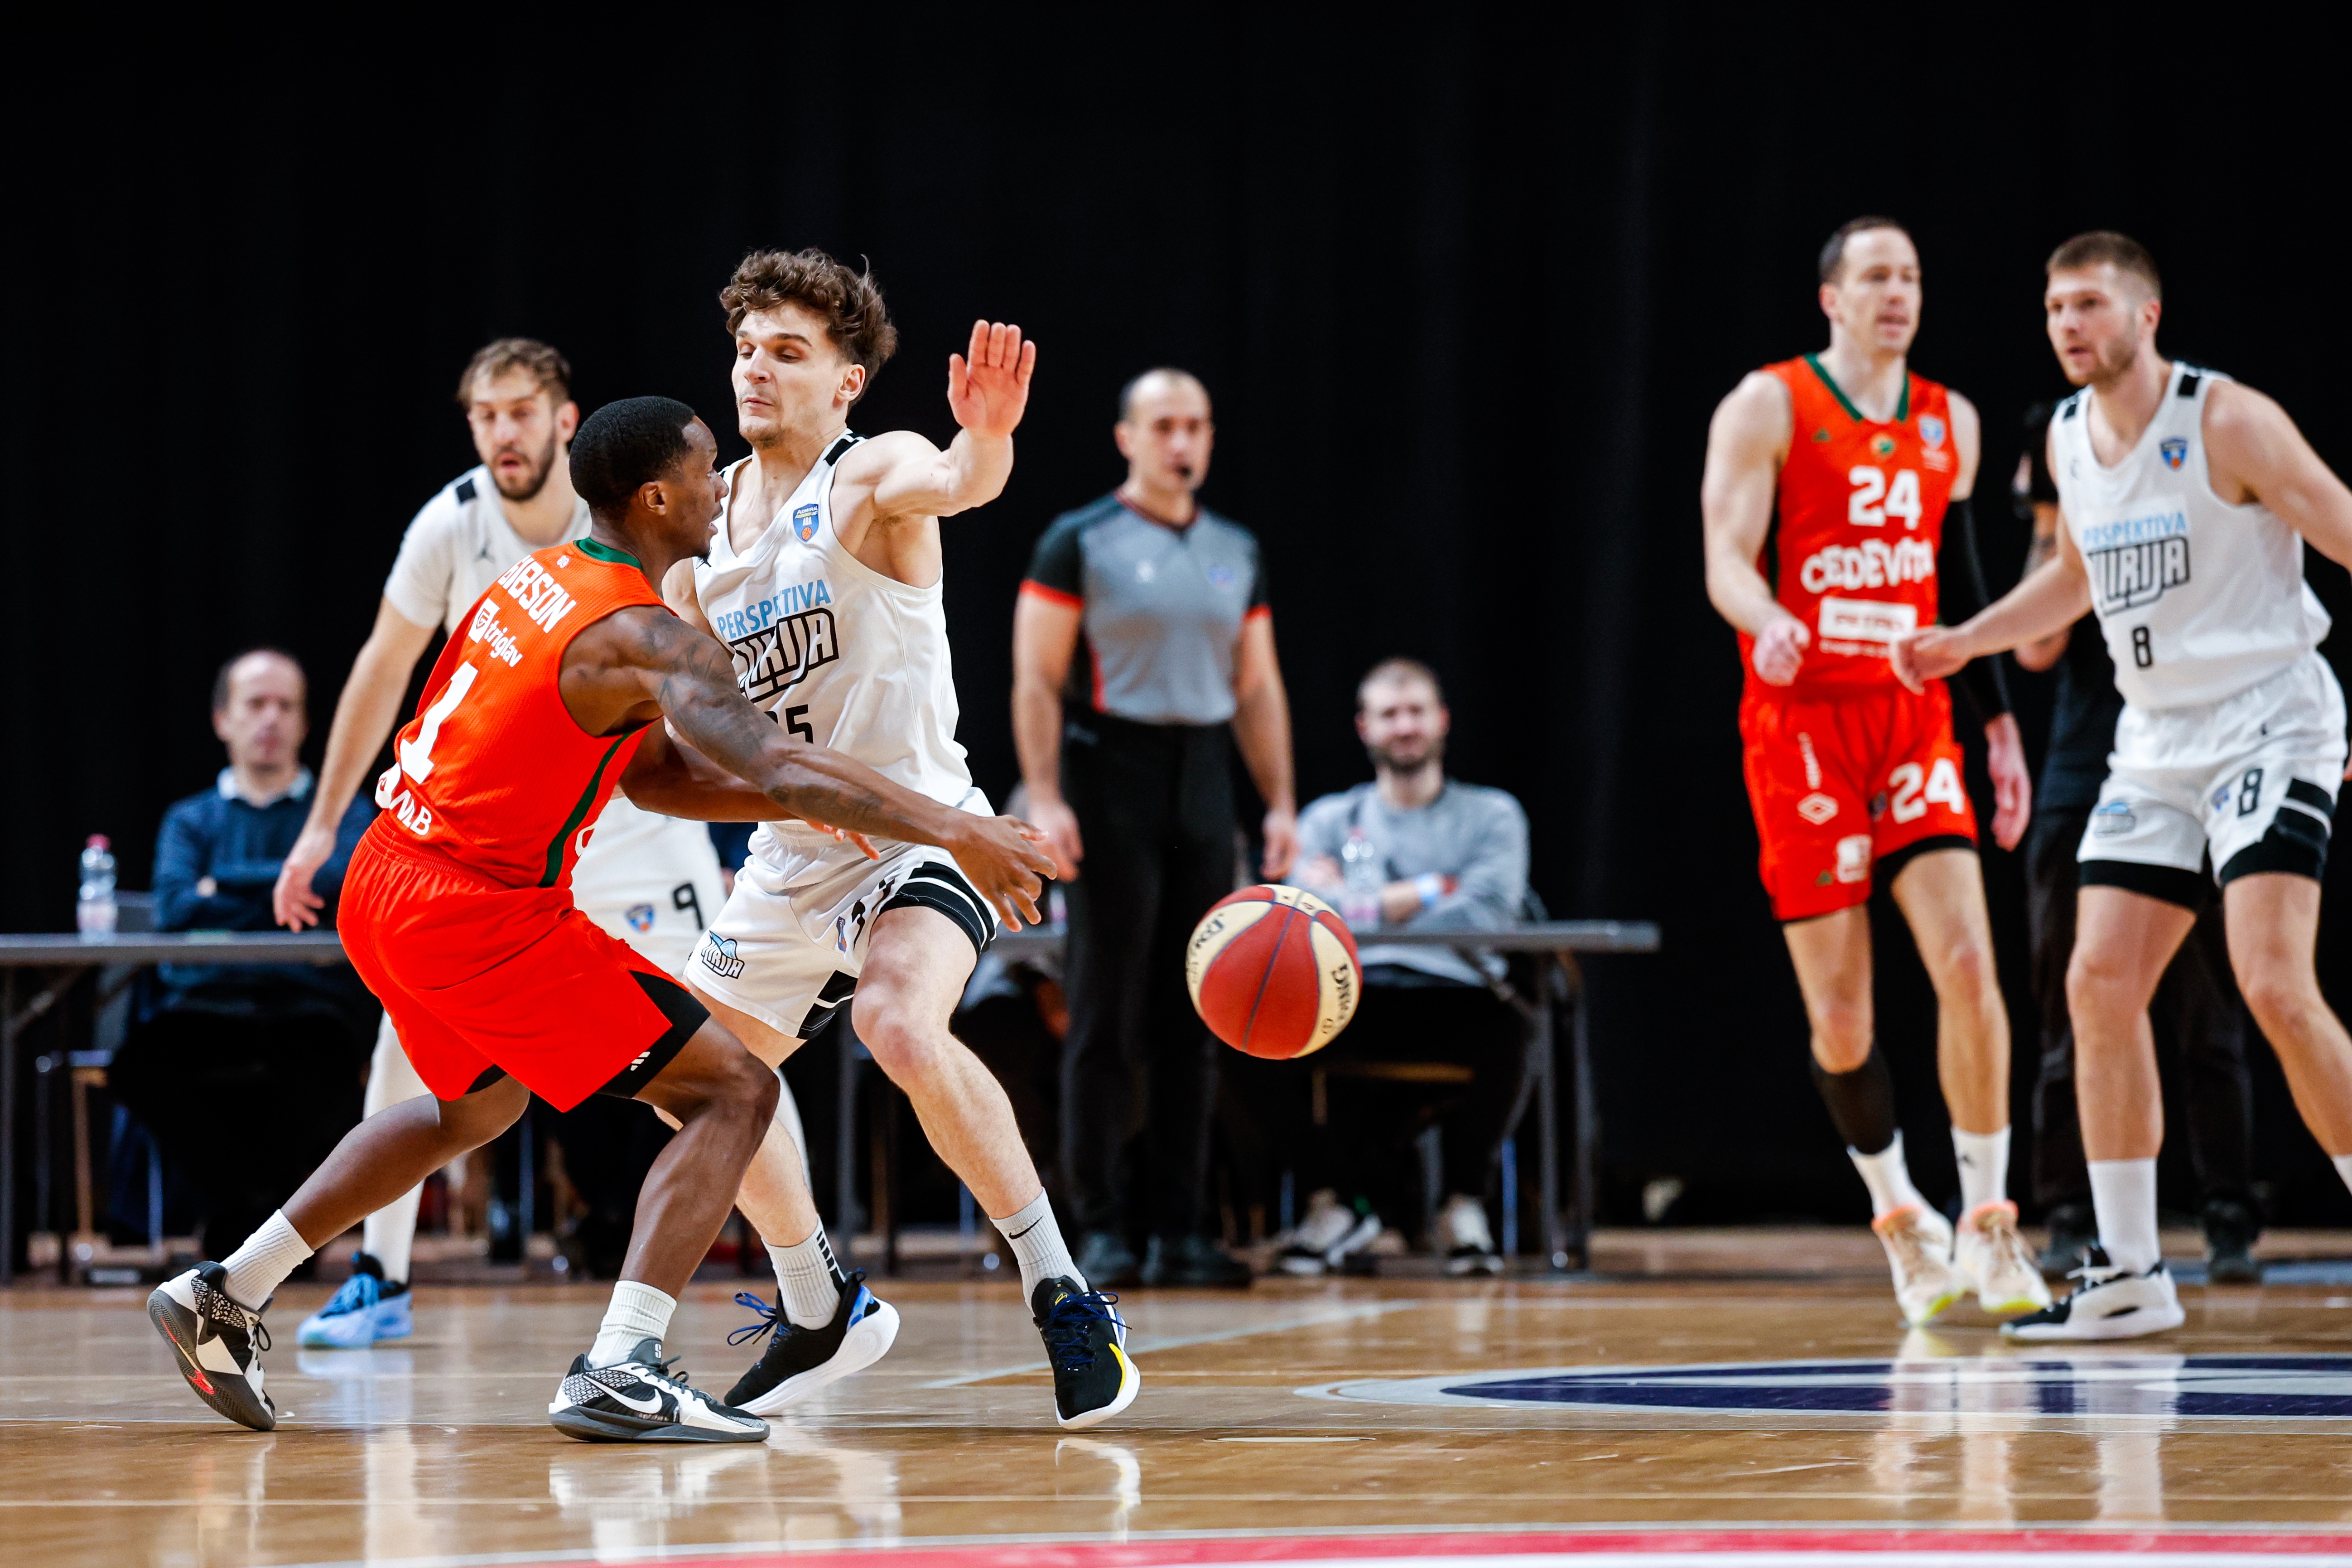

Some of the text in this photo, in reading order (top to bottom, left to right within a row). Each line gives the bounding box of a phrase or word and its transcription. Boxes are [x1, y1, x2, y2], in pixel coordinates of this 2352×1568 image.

[797, 506, 818, 515] ADMIRAL
[802, 517, 812, 526] ABA
[1849, 466, 1922, 530] 24
[484, 620, 523, 668] triglav
[2132, 627, 2152, 668] 8
[400, 661, 478, 785] 1
[764, 704, 814, 745] 5
[389, 789, 432, 836] NLB
[1888, 758, 1964, 824] 24
[2237, 769, 2264, 819] 8
[672, 882, 704, 931] 9
